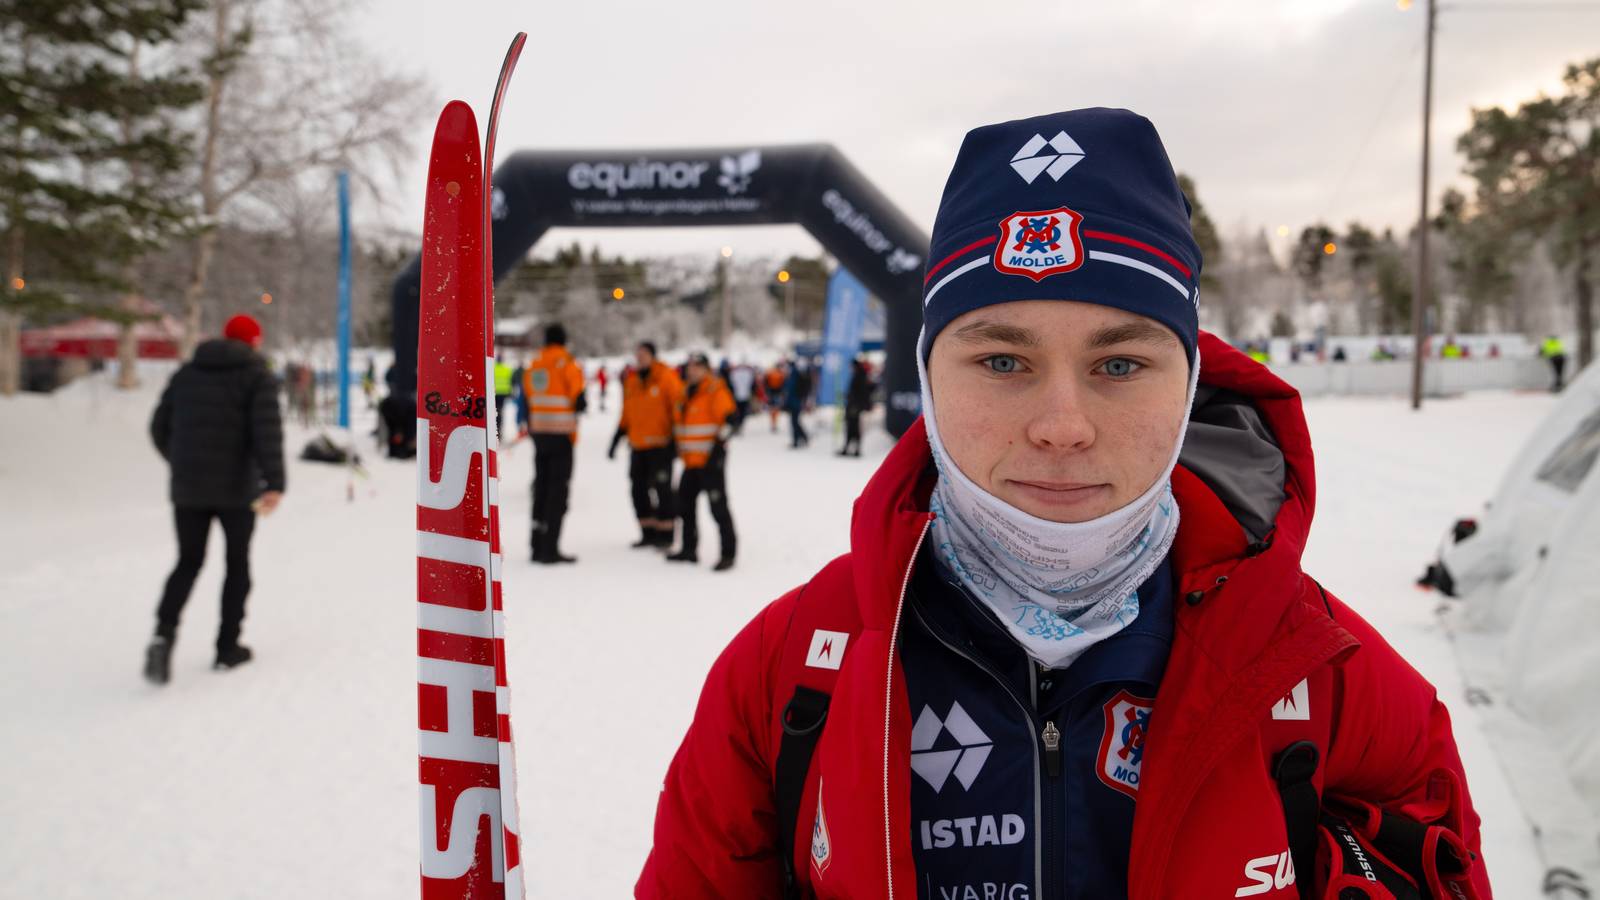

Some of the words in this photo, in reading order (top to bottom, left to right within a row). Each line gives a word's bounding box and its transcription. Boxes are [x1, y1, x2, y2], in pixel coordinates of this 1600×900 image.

[567, 157, 709, 197] equinor
[822, 189, 893, 253] equinor
[1008, 253, 1067, 268] MOLDE
[920, 814, 1025, 850] ISTAD
[940, 882, 1030, 900] VARIG
